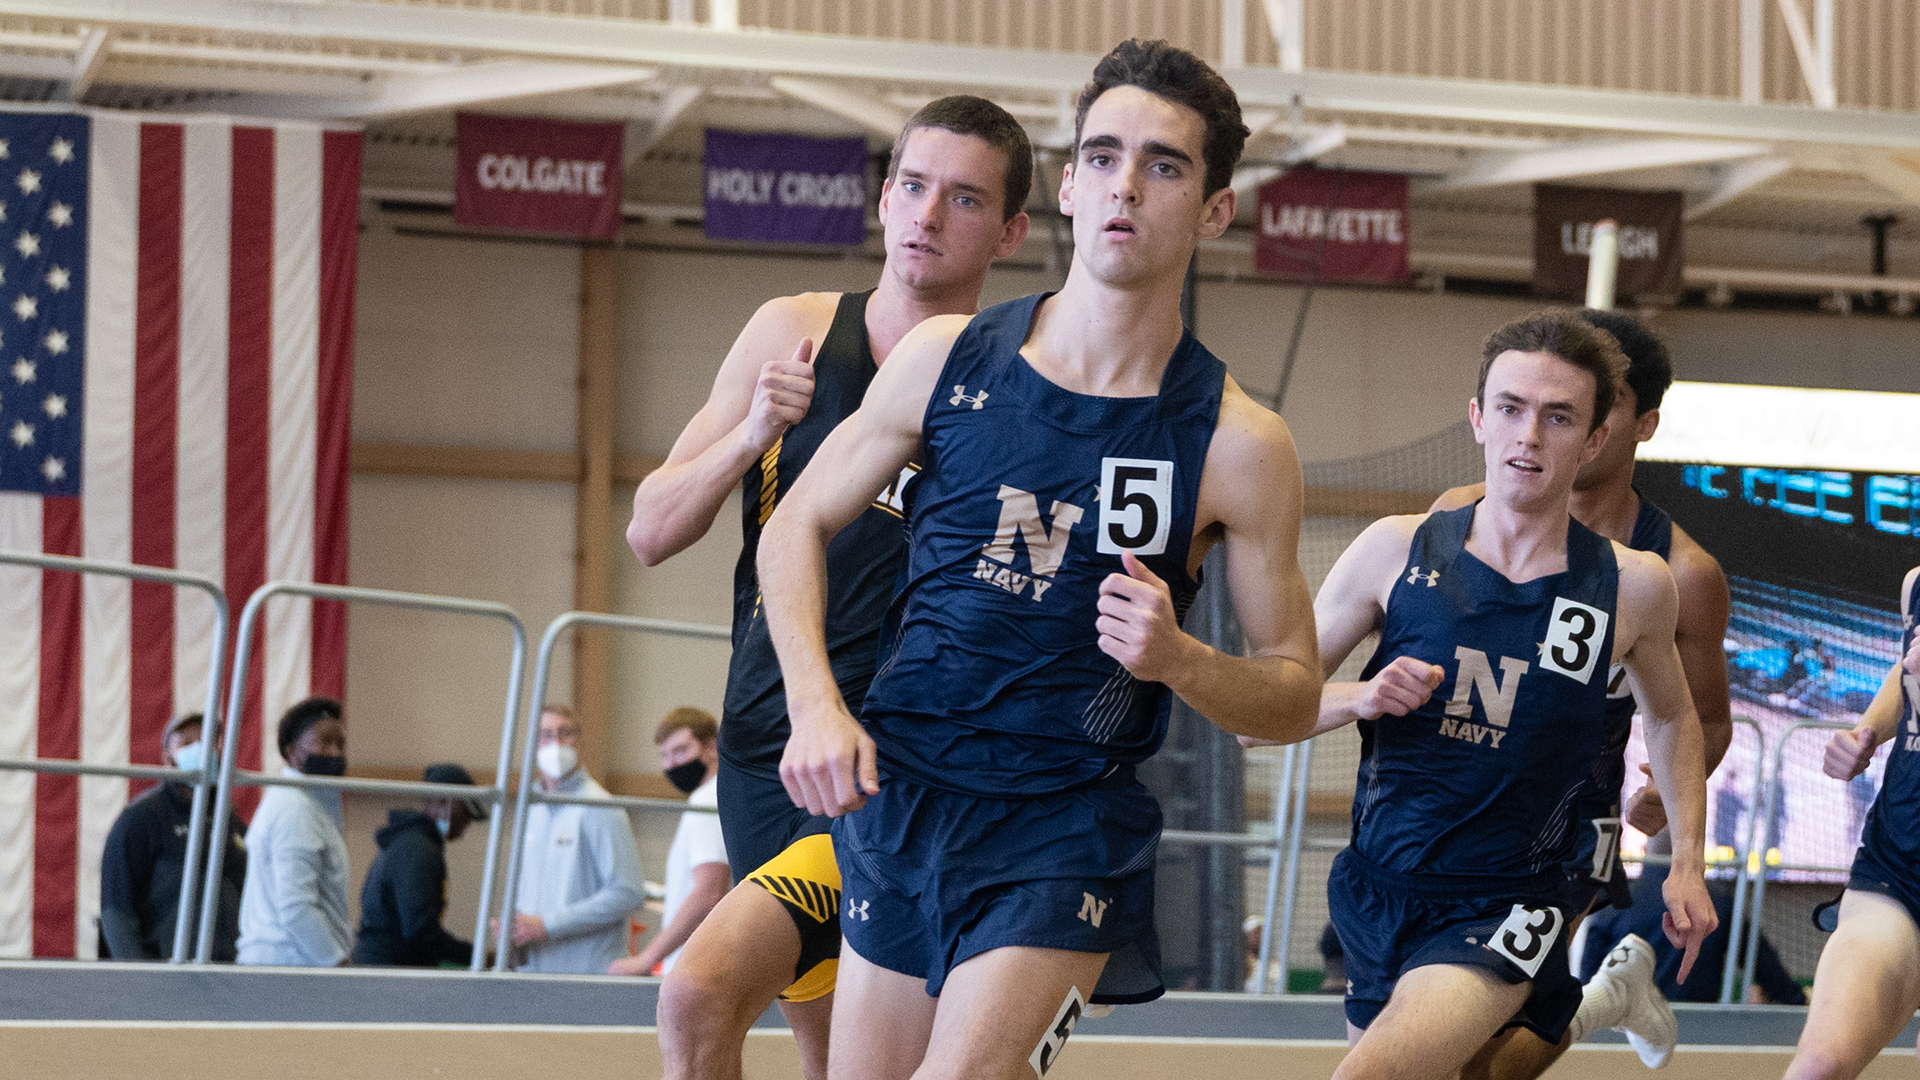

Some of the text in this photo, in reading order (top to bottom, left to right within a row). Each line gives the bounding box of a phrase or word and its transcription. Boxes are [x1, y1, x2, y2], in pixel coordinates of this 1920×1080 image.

[477, 153, 605, 196] COLGATE
[708, 167, 864, 208] HOLY CROSS
[1561, 222, 1659, 260] LEGH
[1108, 466, 1158, 548] 5
[981, 484, 1084, 578] N
[973, 560, 1052, 602] NAVY
[1551, 606, 1596, 672] 3
[1445, 645, 1529, 728] N
[1438, 717, 1507, 748] NAVY
[1077, 892, 1107, 928] N
[1502, 904, 1555, 961] 3
